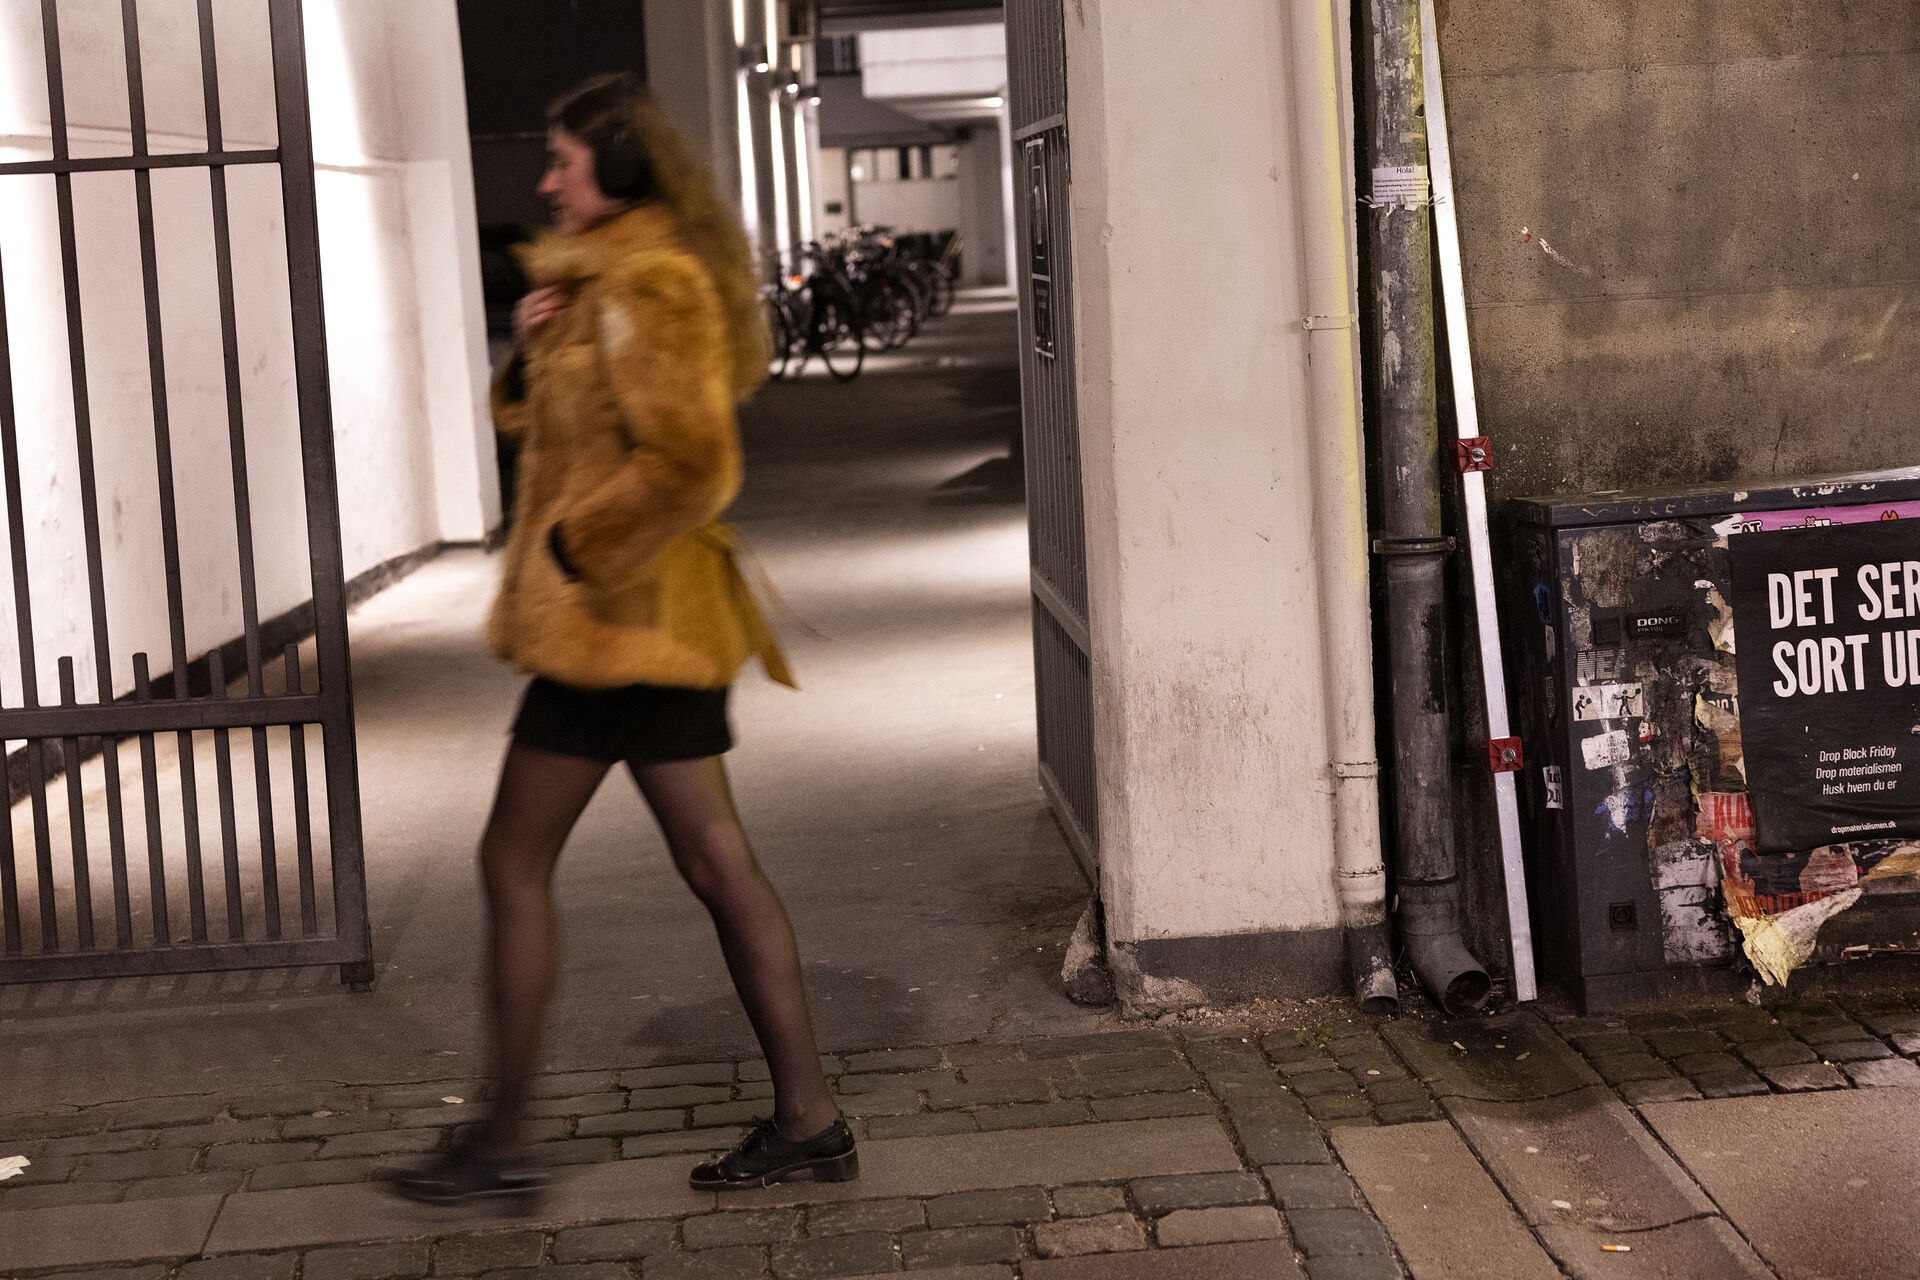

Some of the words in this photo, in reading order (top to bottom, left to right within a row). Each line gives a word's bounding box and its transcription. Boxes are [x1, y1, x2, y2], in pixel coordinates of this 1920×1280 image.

[1768, 568, 1839, 629] DET
[1637, 616, 1679, 627] DONG
[1772, 634, 1869, 698] SORT
[1819, 750, 1841, 763] Drop
[1843, 747, 1868, 760] Black
[1869, 745, 1897, 759] Friday
[1815, 767, 1837, 780] Drop
[1839, 762, 1902, 777] materialismen
[1822, 783, 1845, 795] Husk
[1847, 781, 1871, 793] hvem
[1873, 779, 1885, 791] du
[1887, 780, 1898, 789] er
[1831, 820, 1897, 834] dropmaterialismen.dk
